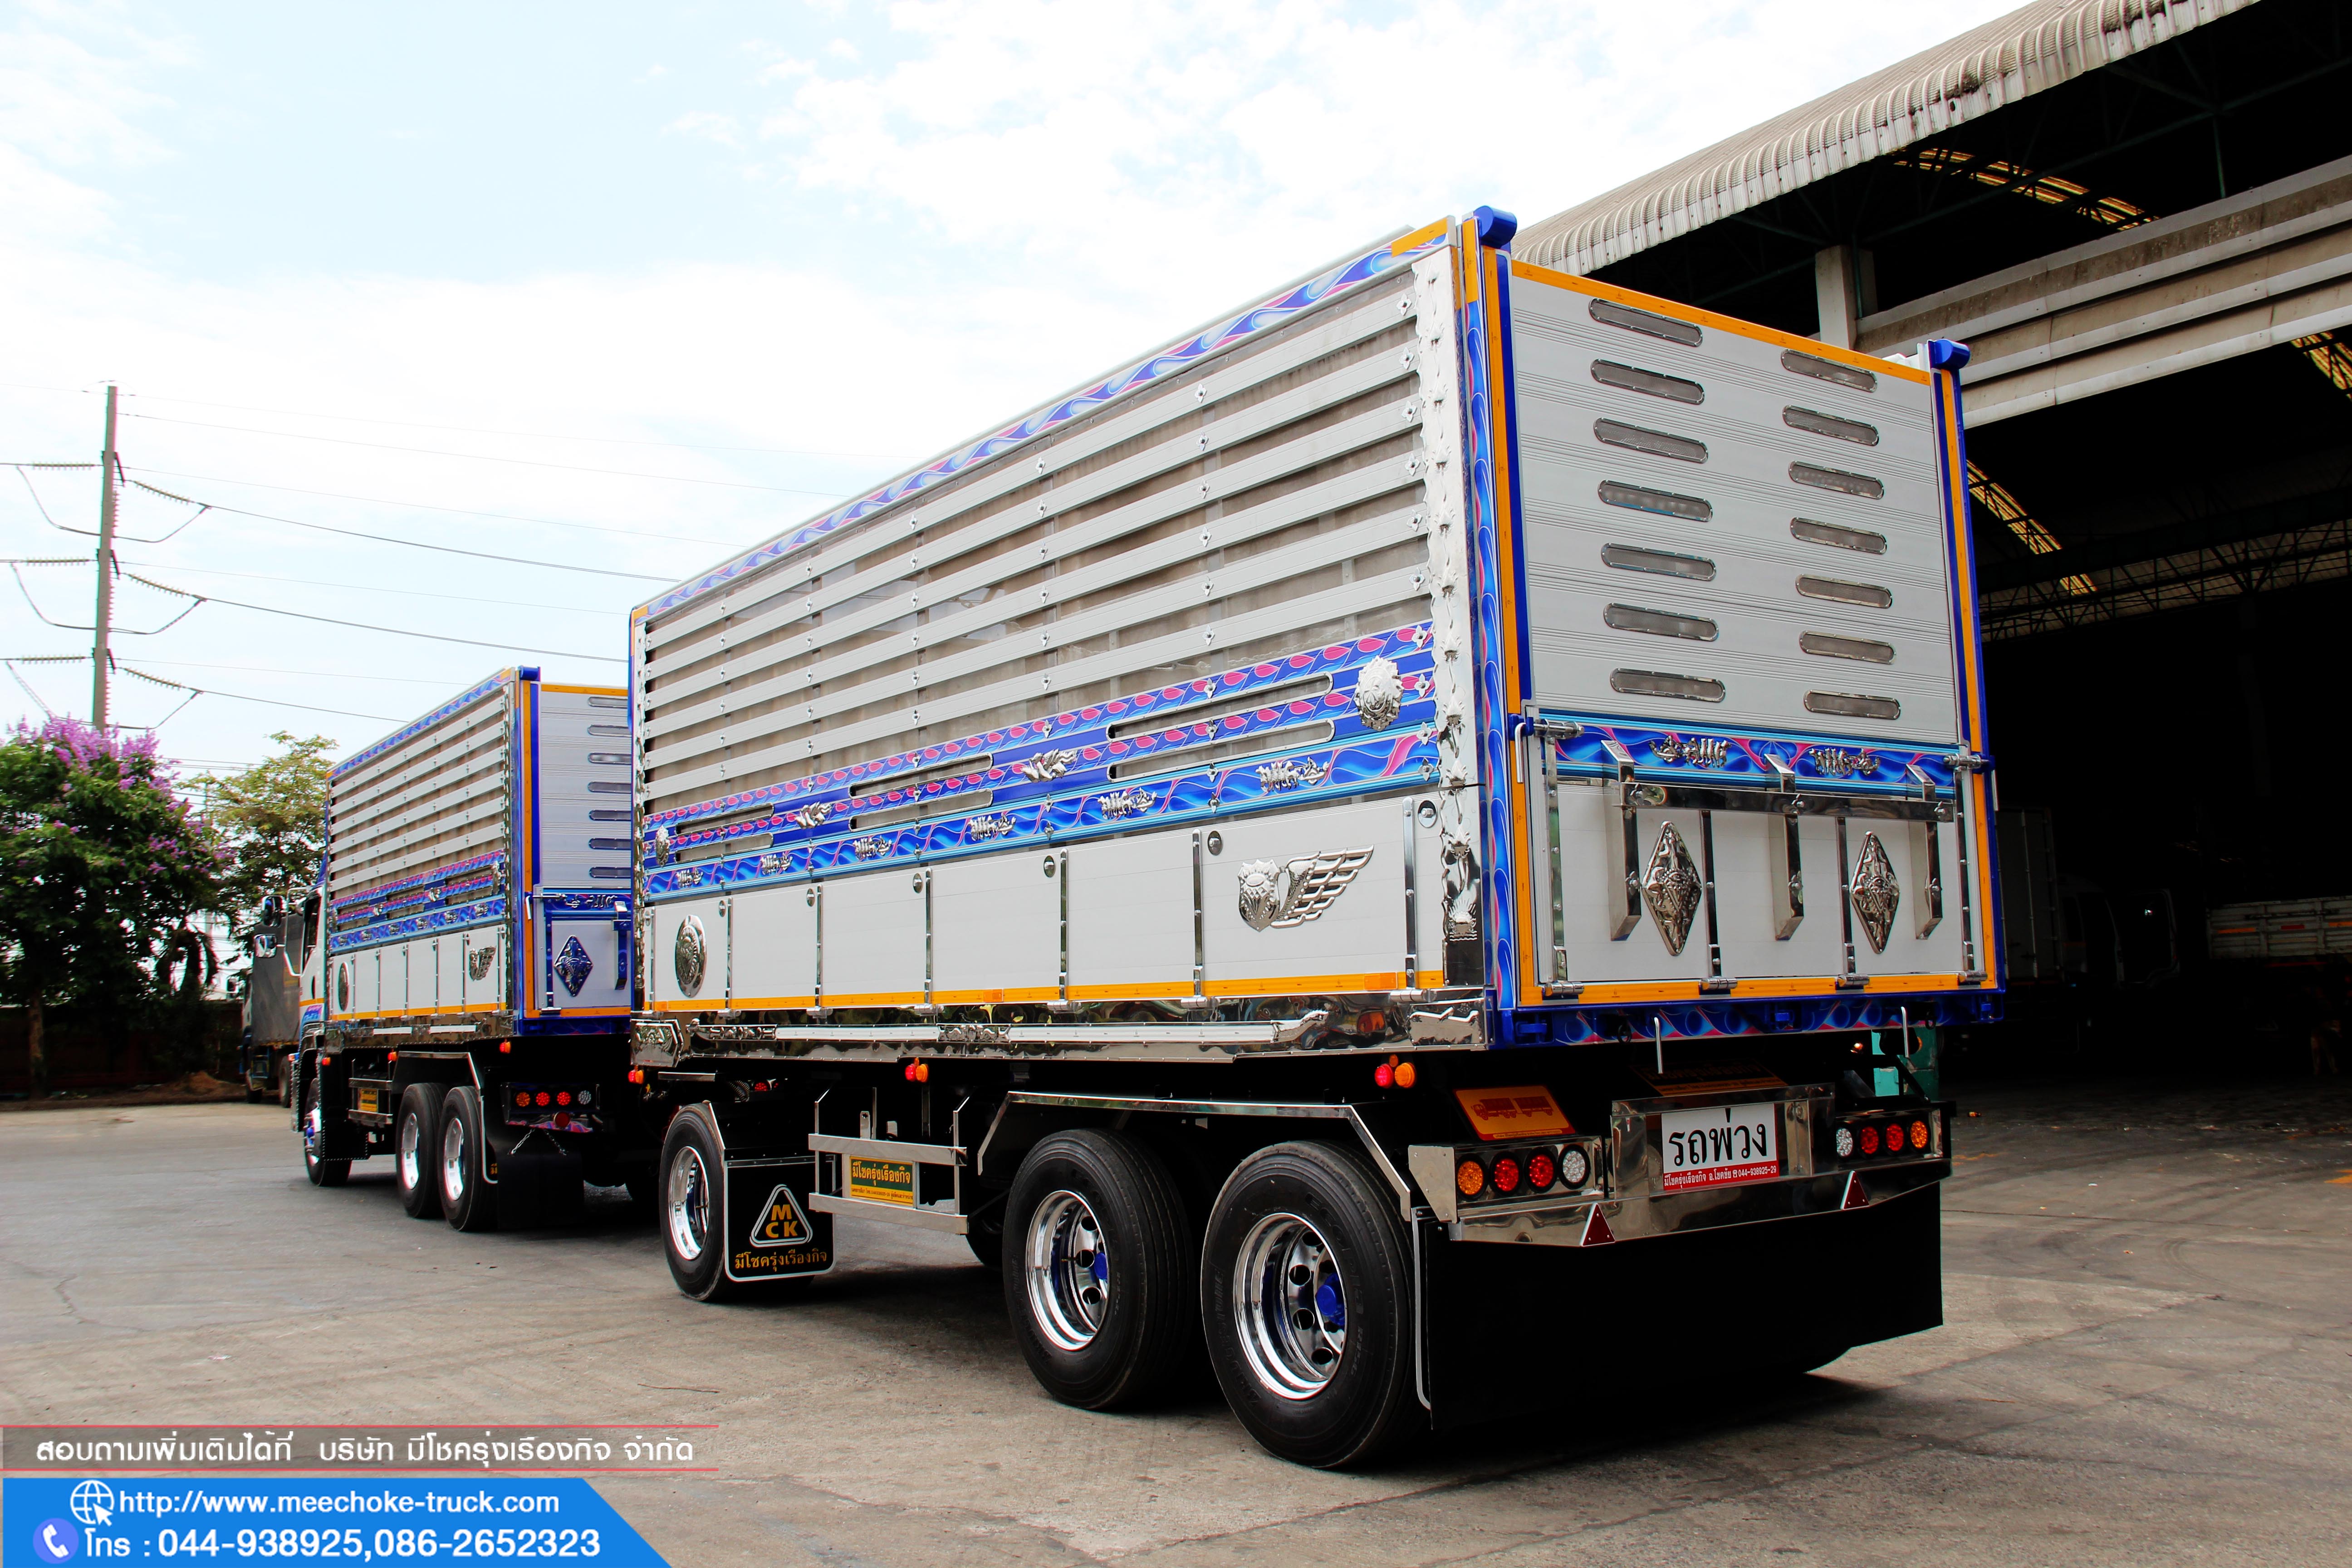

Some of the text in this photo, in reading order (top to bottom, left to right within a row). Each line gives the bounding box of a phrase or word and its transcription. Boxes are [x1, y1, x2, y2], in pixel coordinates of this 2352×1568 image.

[1668, 1107, 1767, 1166] รถพ่วง
[852, 1161, 911, 1186] มีโชครุ่งเรืองกิจ
[1738, 1165, 1777, 1178] 044-938925-29
[771, 1204, 792, 1221] M
[735, 1247, 828, 1272] มีโชครุ่งเรืองกิจ
